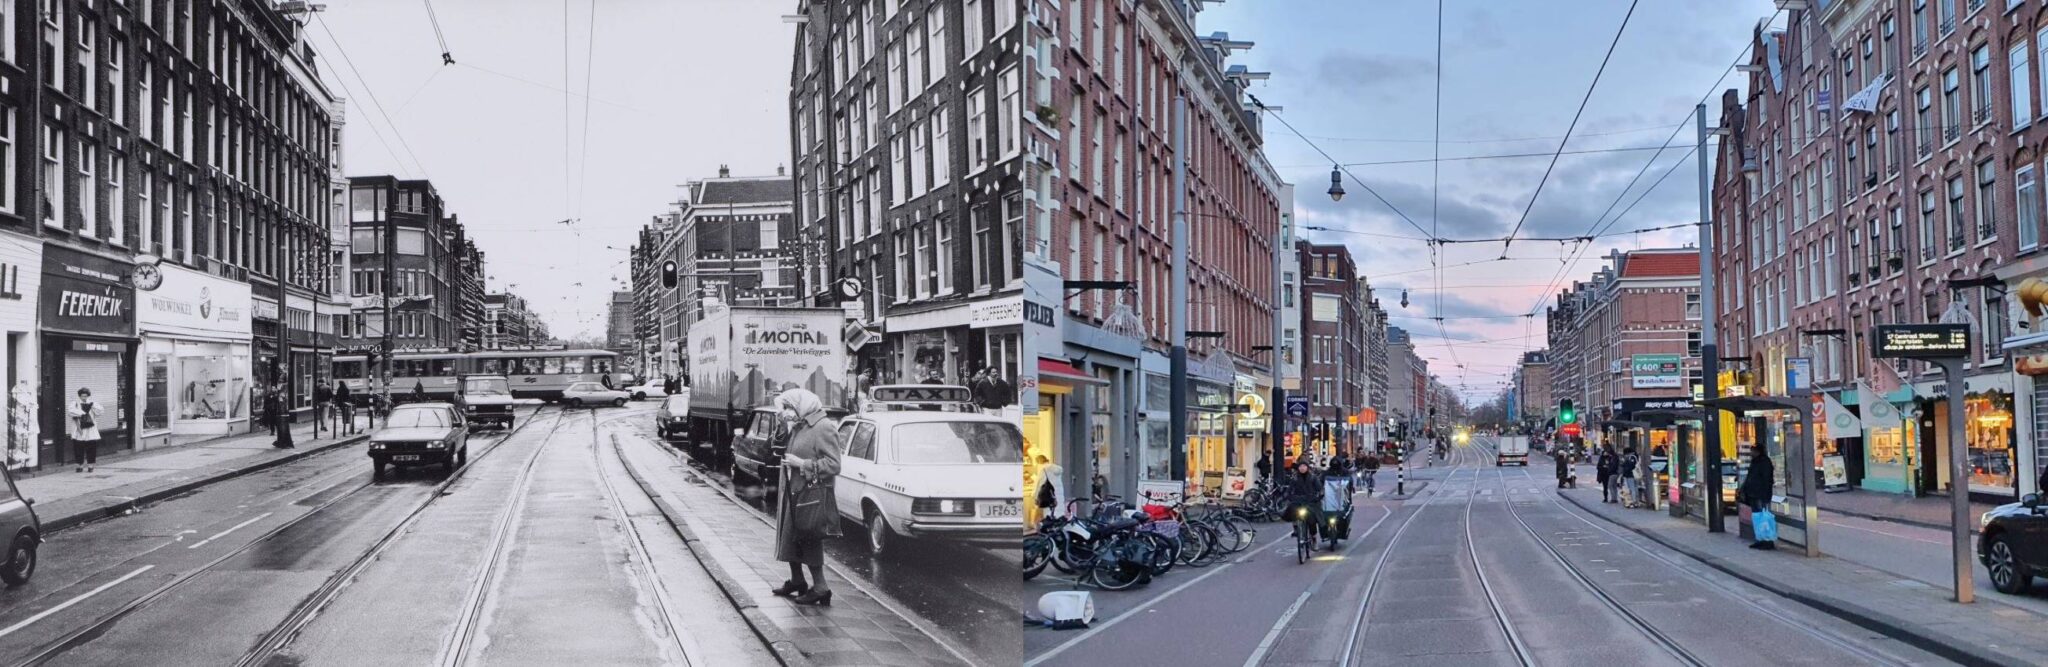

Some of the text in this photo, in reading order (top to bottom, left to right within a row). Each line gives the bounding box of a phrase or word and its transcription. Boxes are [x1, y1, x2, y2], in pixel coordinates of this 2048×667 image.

[982, 302, 1021, 321] COFFEESHOP
[759, 331, 814, 344] MONA
[1636, 363, 1658, 372] €400
[888, 389, 955, 400] TAXI
